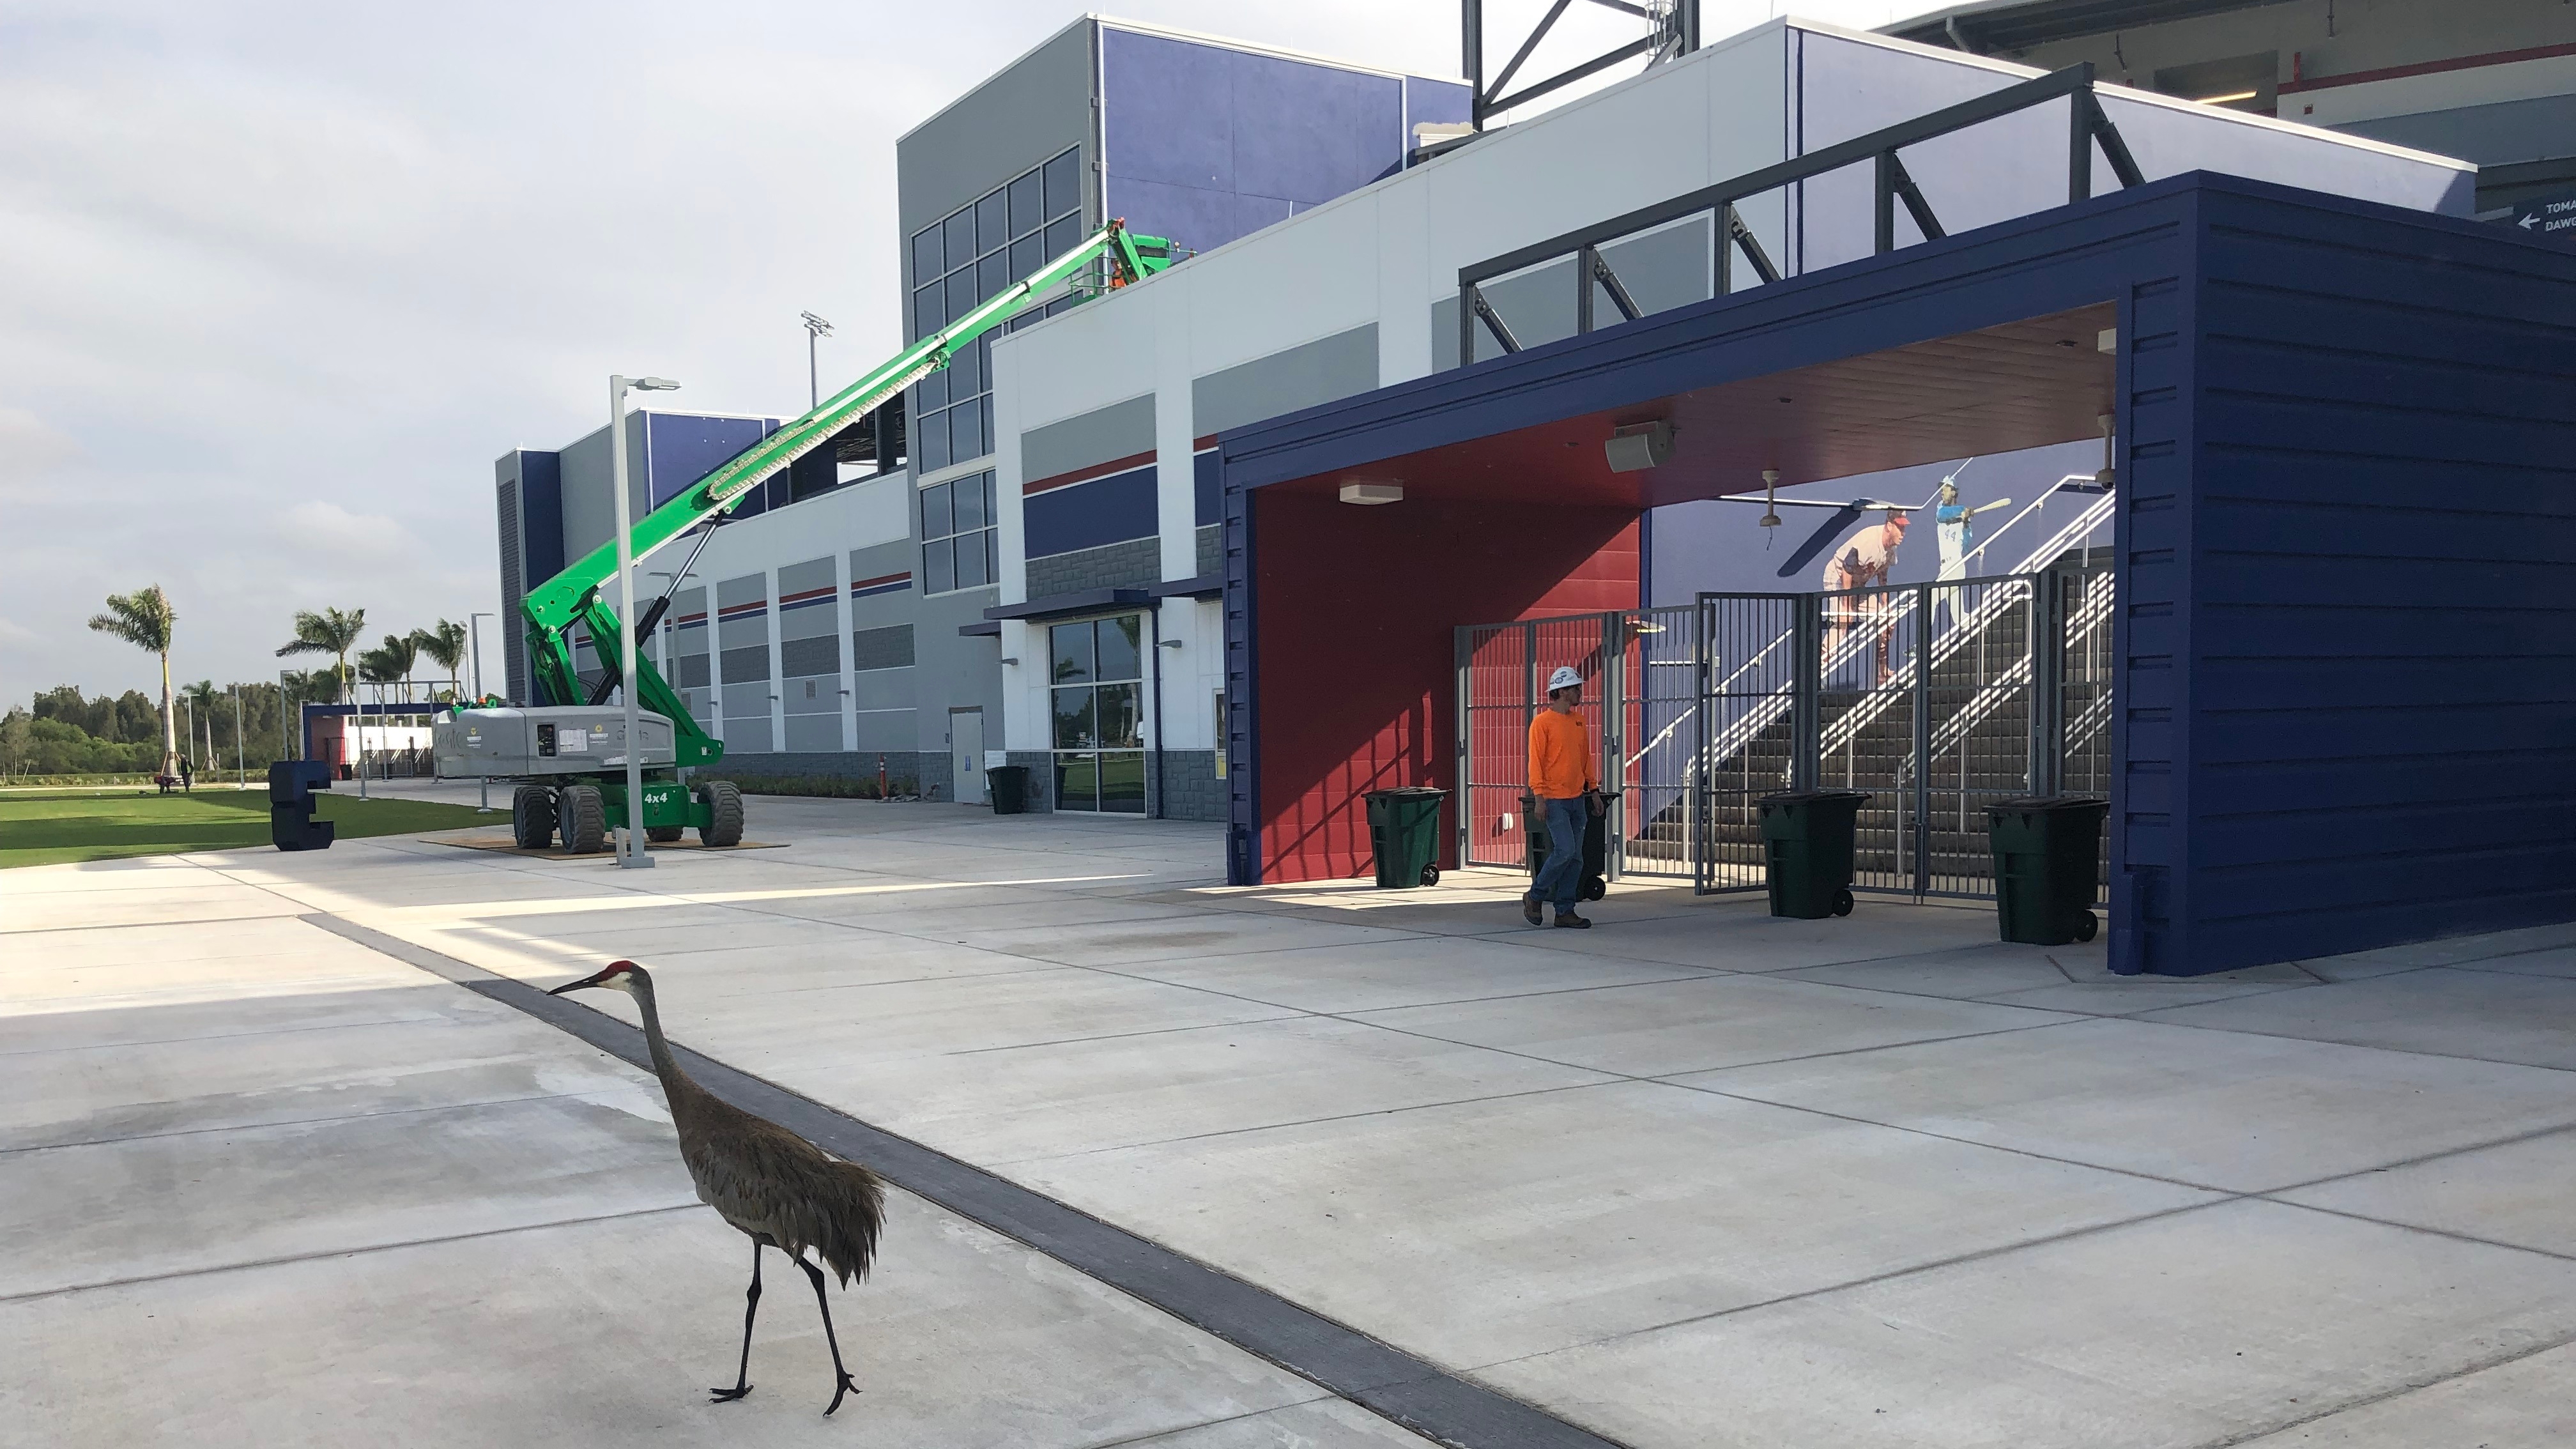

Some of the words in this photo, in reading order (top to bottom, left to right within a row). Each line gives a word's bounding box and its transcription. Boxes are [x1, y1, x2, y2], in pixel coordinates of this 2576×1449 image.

[2546, 199, 2576, 214] TOMA
[2545, 217, 2576, 231] DAWG
[645, 792, 668, 803] 4x4
